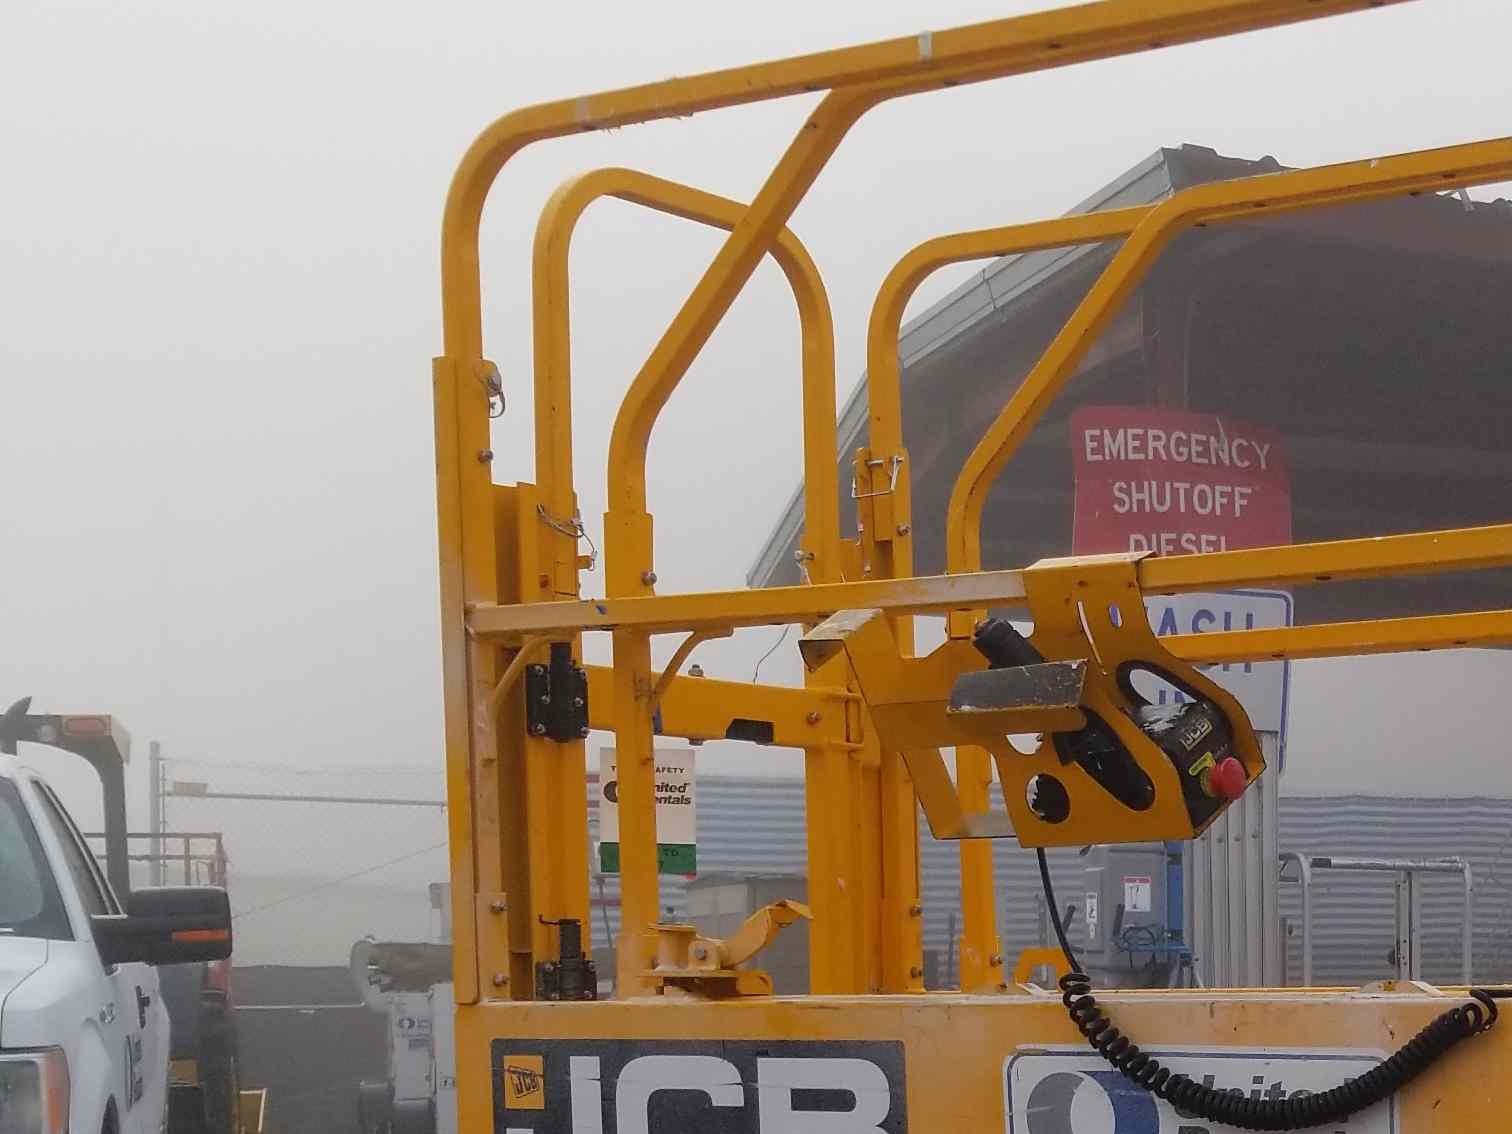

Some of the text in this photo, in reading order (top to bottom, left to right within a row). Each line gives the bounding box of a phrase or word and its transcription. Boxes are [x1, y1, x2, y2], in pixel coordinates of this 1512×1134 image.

[1084, 428, 1272, 470] EMERGENCY
[1113, 480, 1252, 518] SHUTOFF
[656, 766, 685, 774] AFETY
[655, 782, 689, 794] nited
[655, 794, 692, 806] ntals
